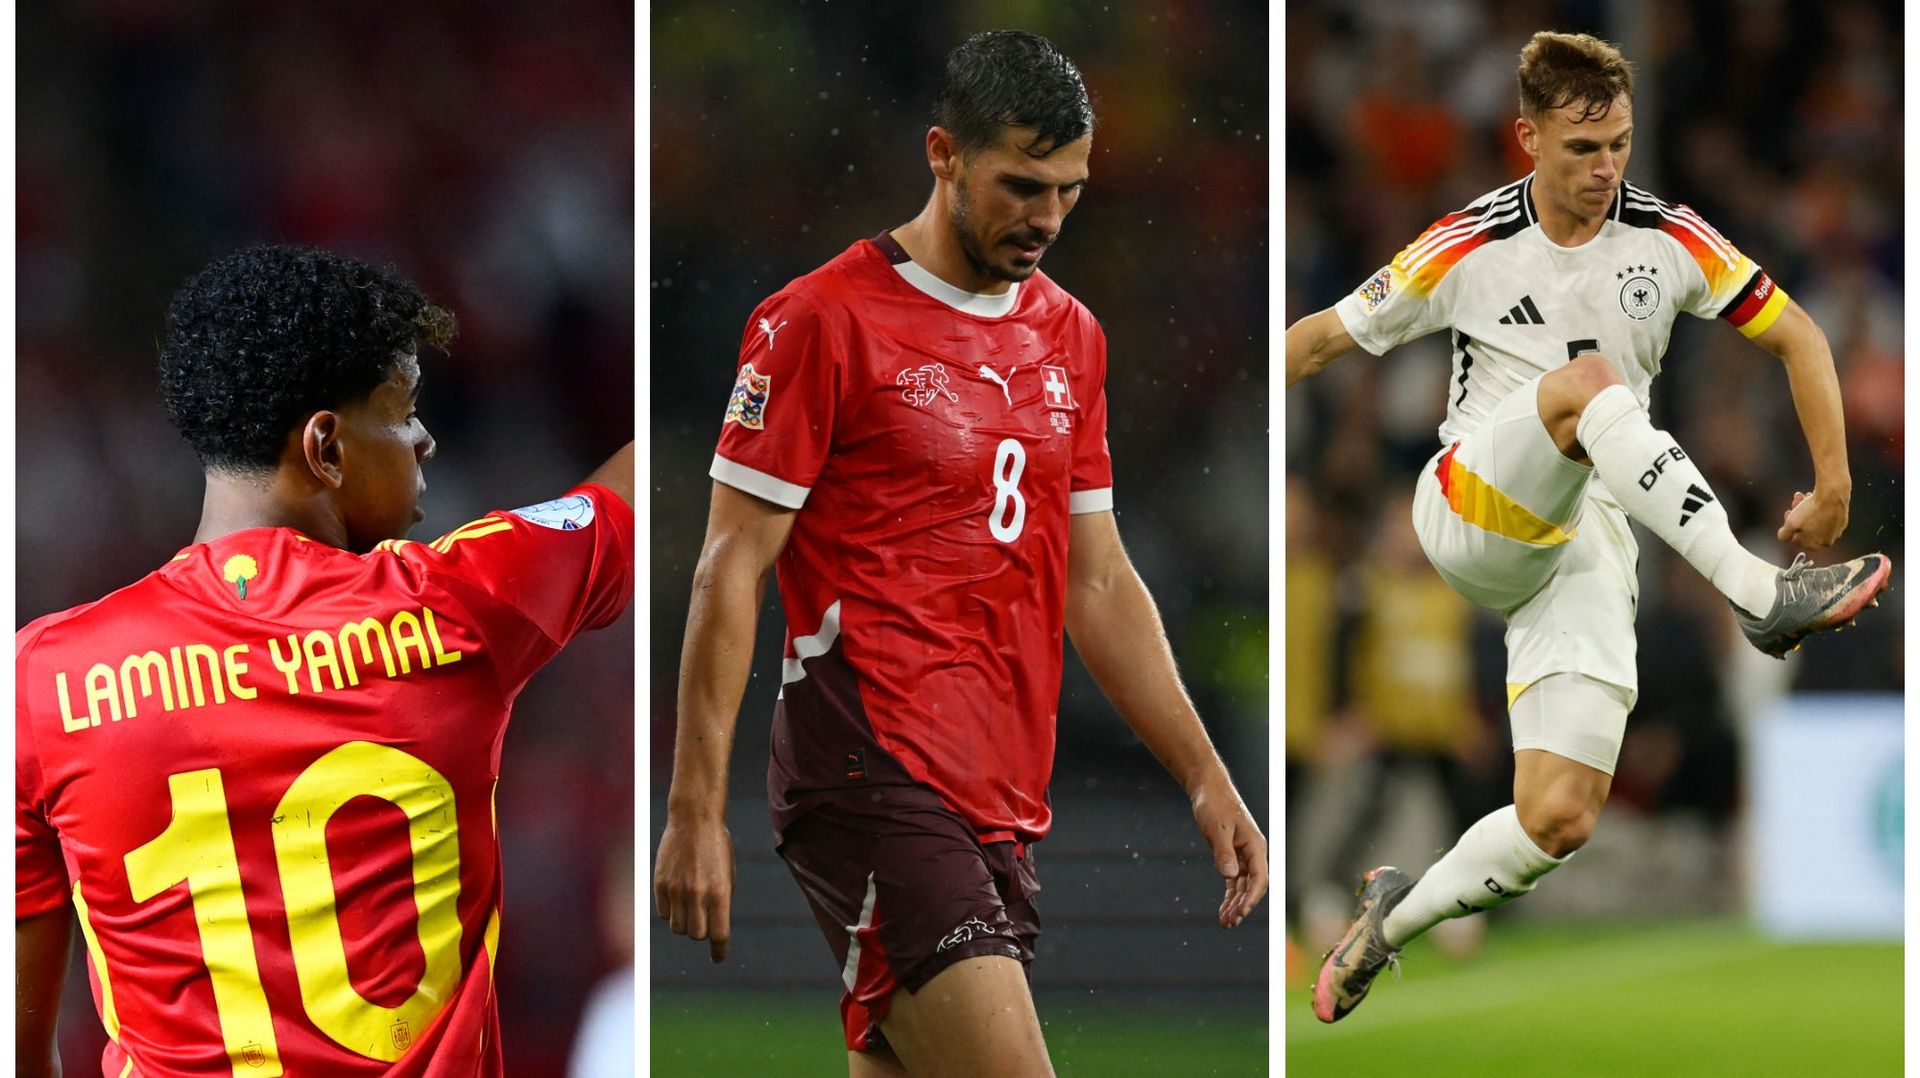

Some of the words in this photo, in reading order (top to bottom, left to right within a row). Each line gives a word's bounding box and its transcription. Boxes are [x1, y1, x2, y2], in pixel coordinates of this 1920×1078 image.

[988, 438, 1026, 543] 8
[1638, 446, 1686, 492] DFB
[55, 643, 259, 733] LAMINE
[269, 605, 462, 695] YAMAL
[123, 740, 464, 1077] 10
